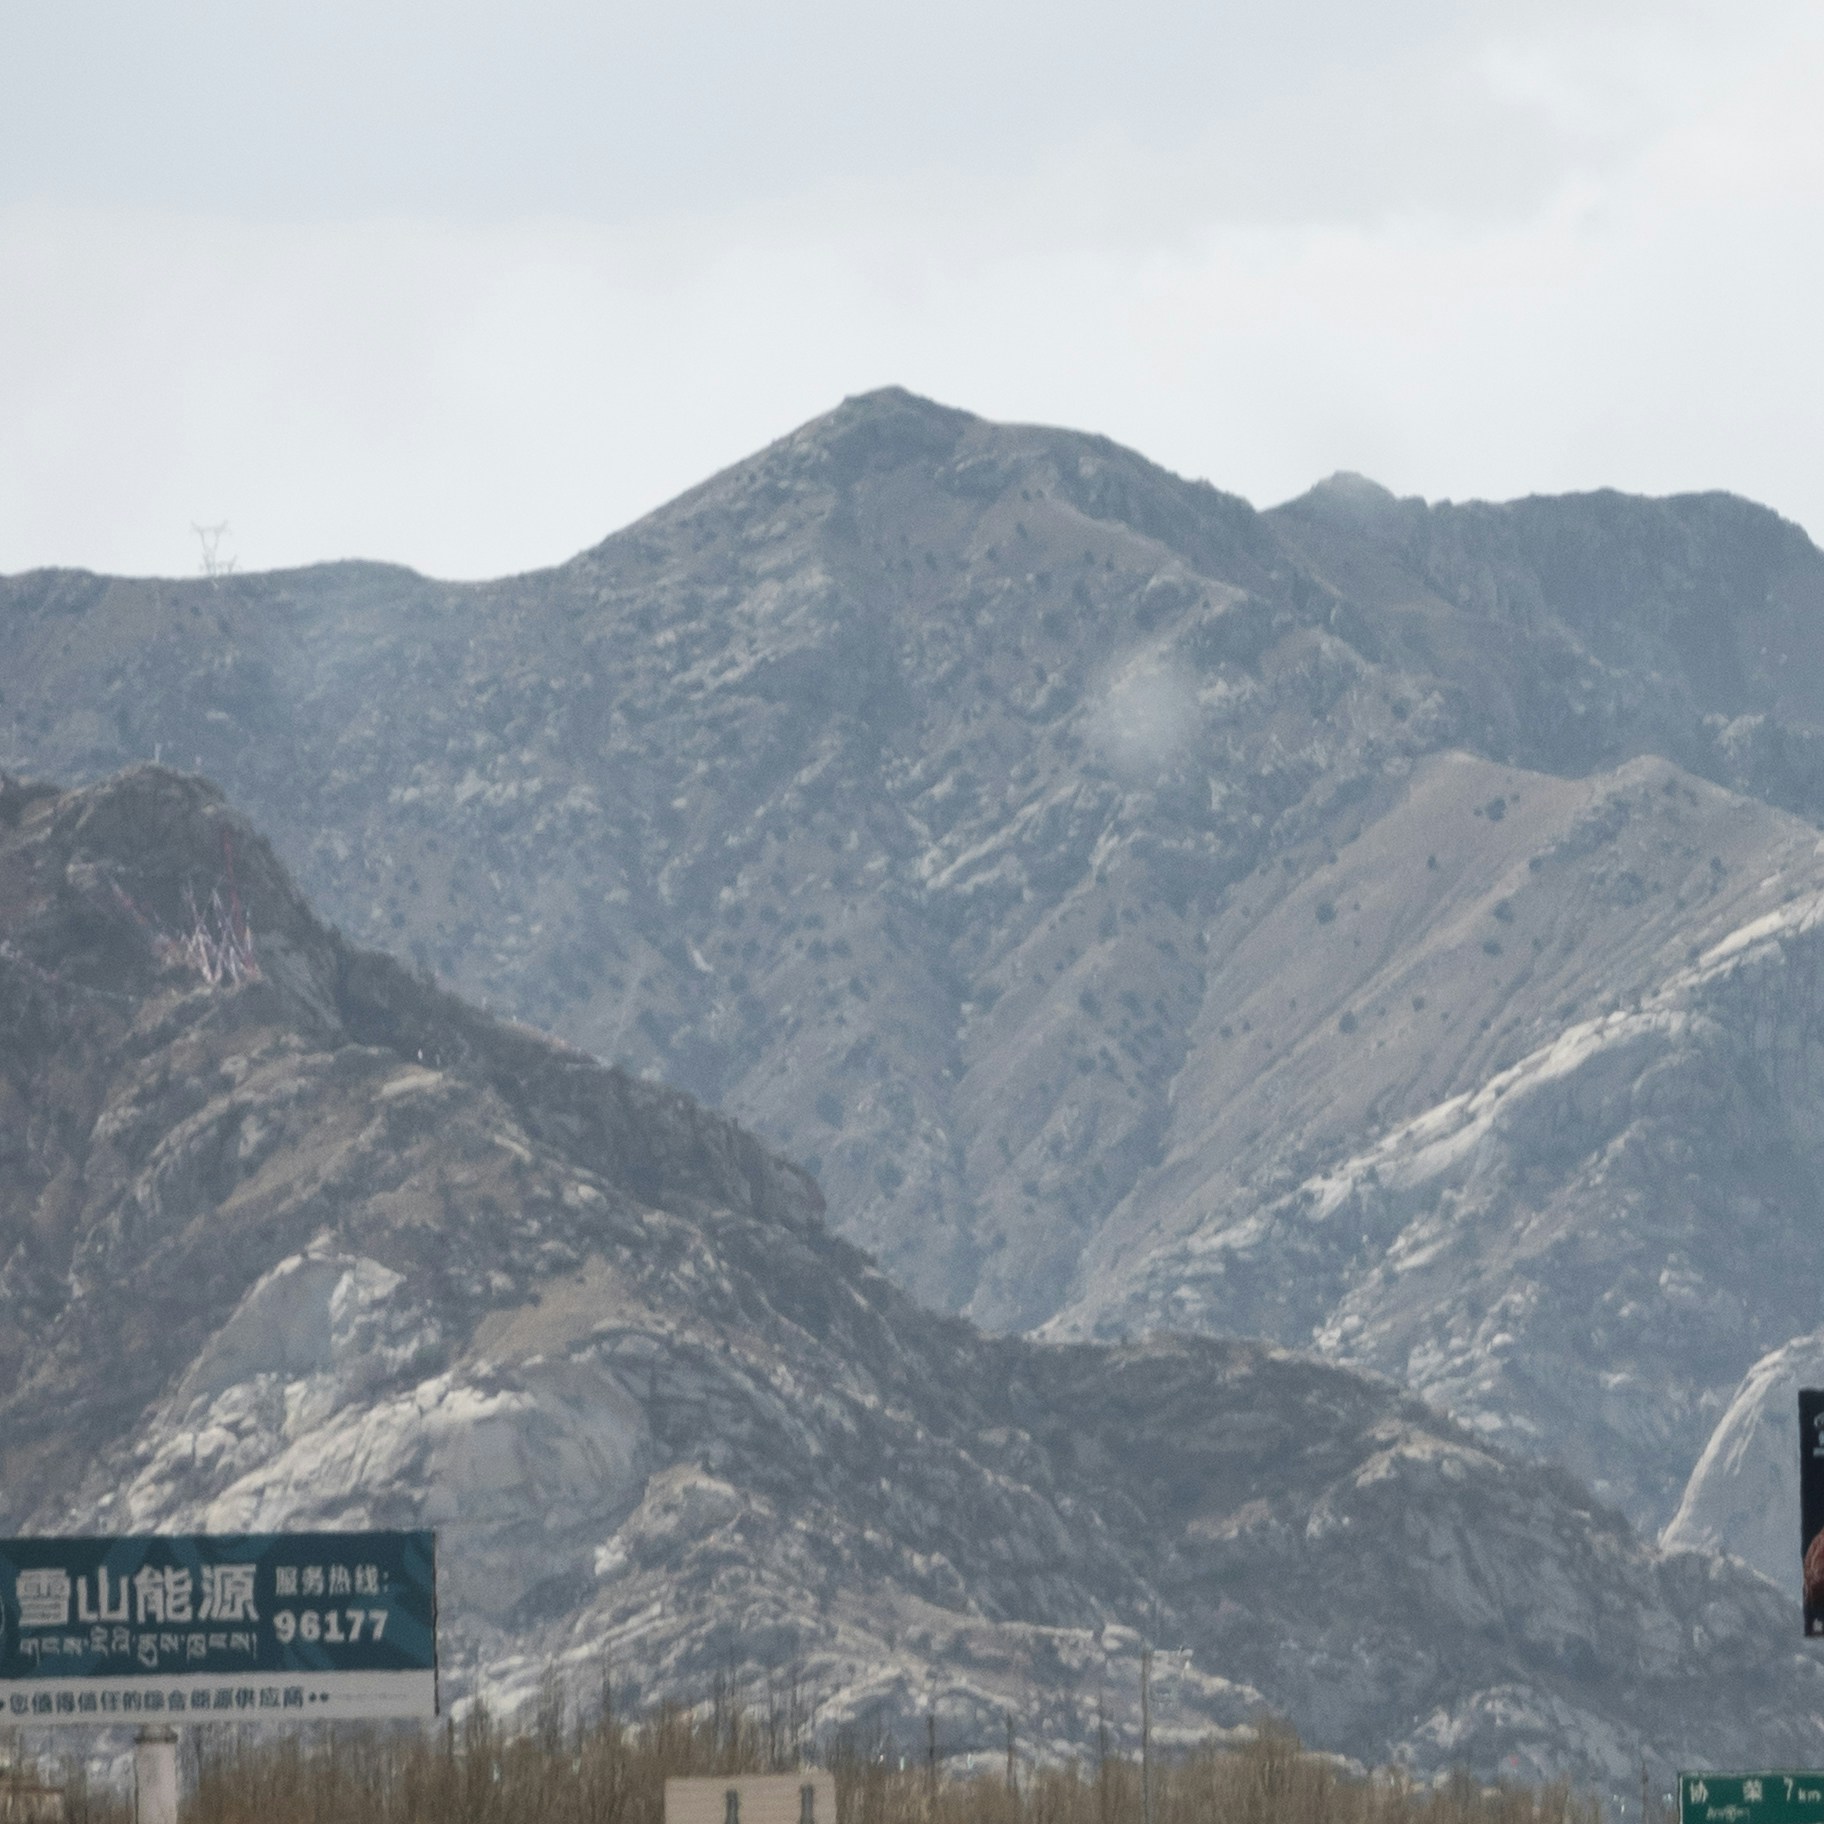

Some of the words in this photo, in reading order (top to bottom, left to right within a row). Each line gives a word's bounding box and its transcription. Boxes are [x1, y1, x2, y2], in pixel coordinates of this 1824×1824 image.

[15, 1563, 260, 1628] 雪山能源
[272, 1609, 390, 1644] 96177
